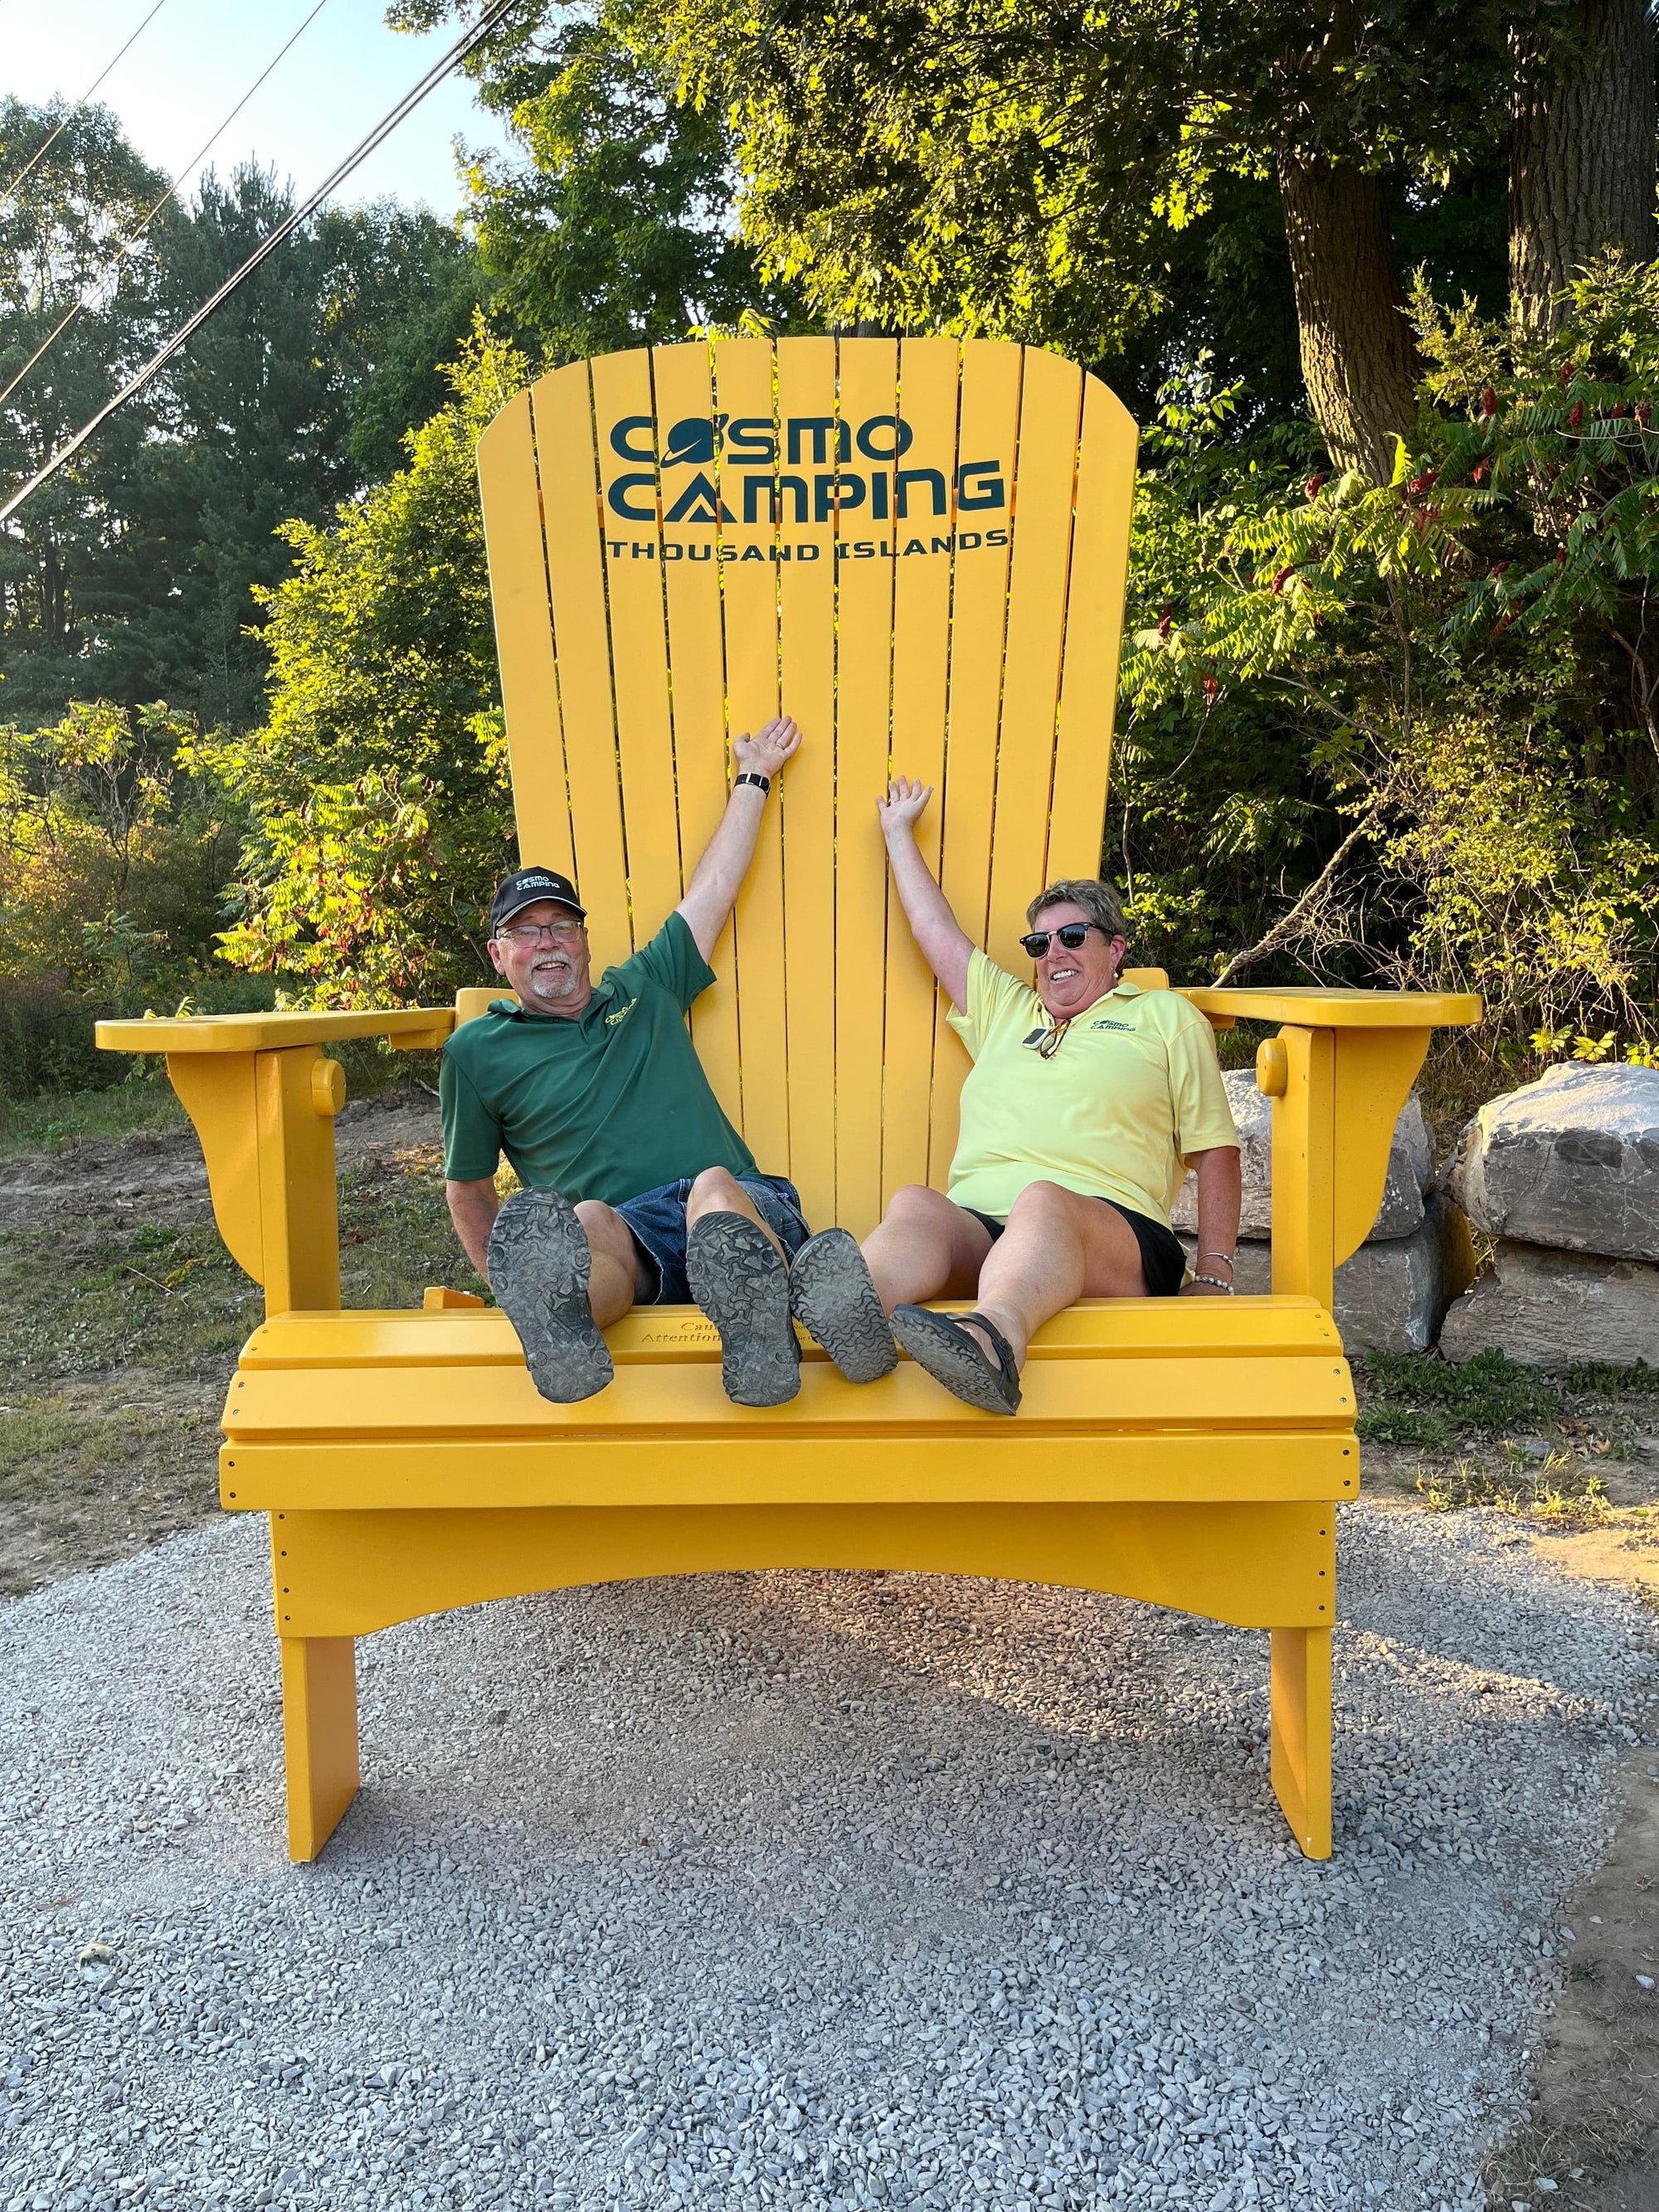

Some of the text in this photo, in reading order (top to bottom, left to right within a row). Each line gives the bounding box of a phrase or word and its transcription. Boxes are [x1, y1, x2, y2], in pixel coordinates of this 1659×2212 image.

[610, 413, 913, 469] COSMO
[608, 459, 1005, 523] CAMPING
[606, 529, 1009, 562] THOUSAND ISLANDS
[517, 882, 560, 891] CAMPING
[681, 1322, 716, 1331] Cau
